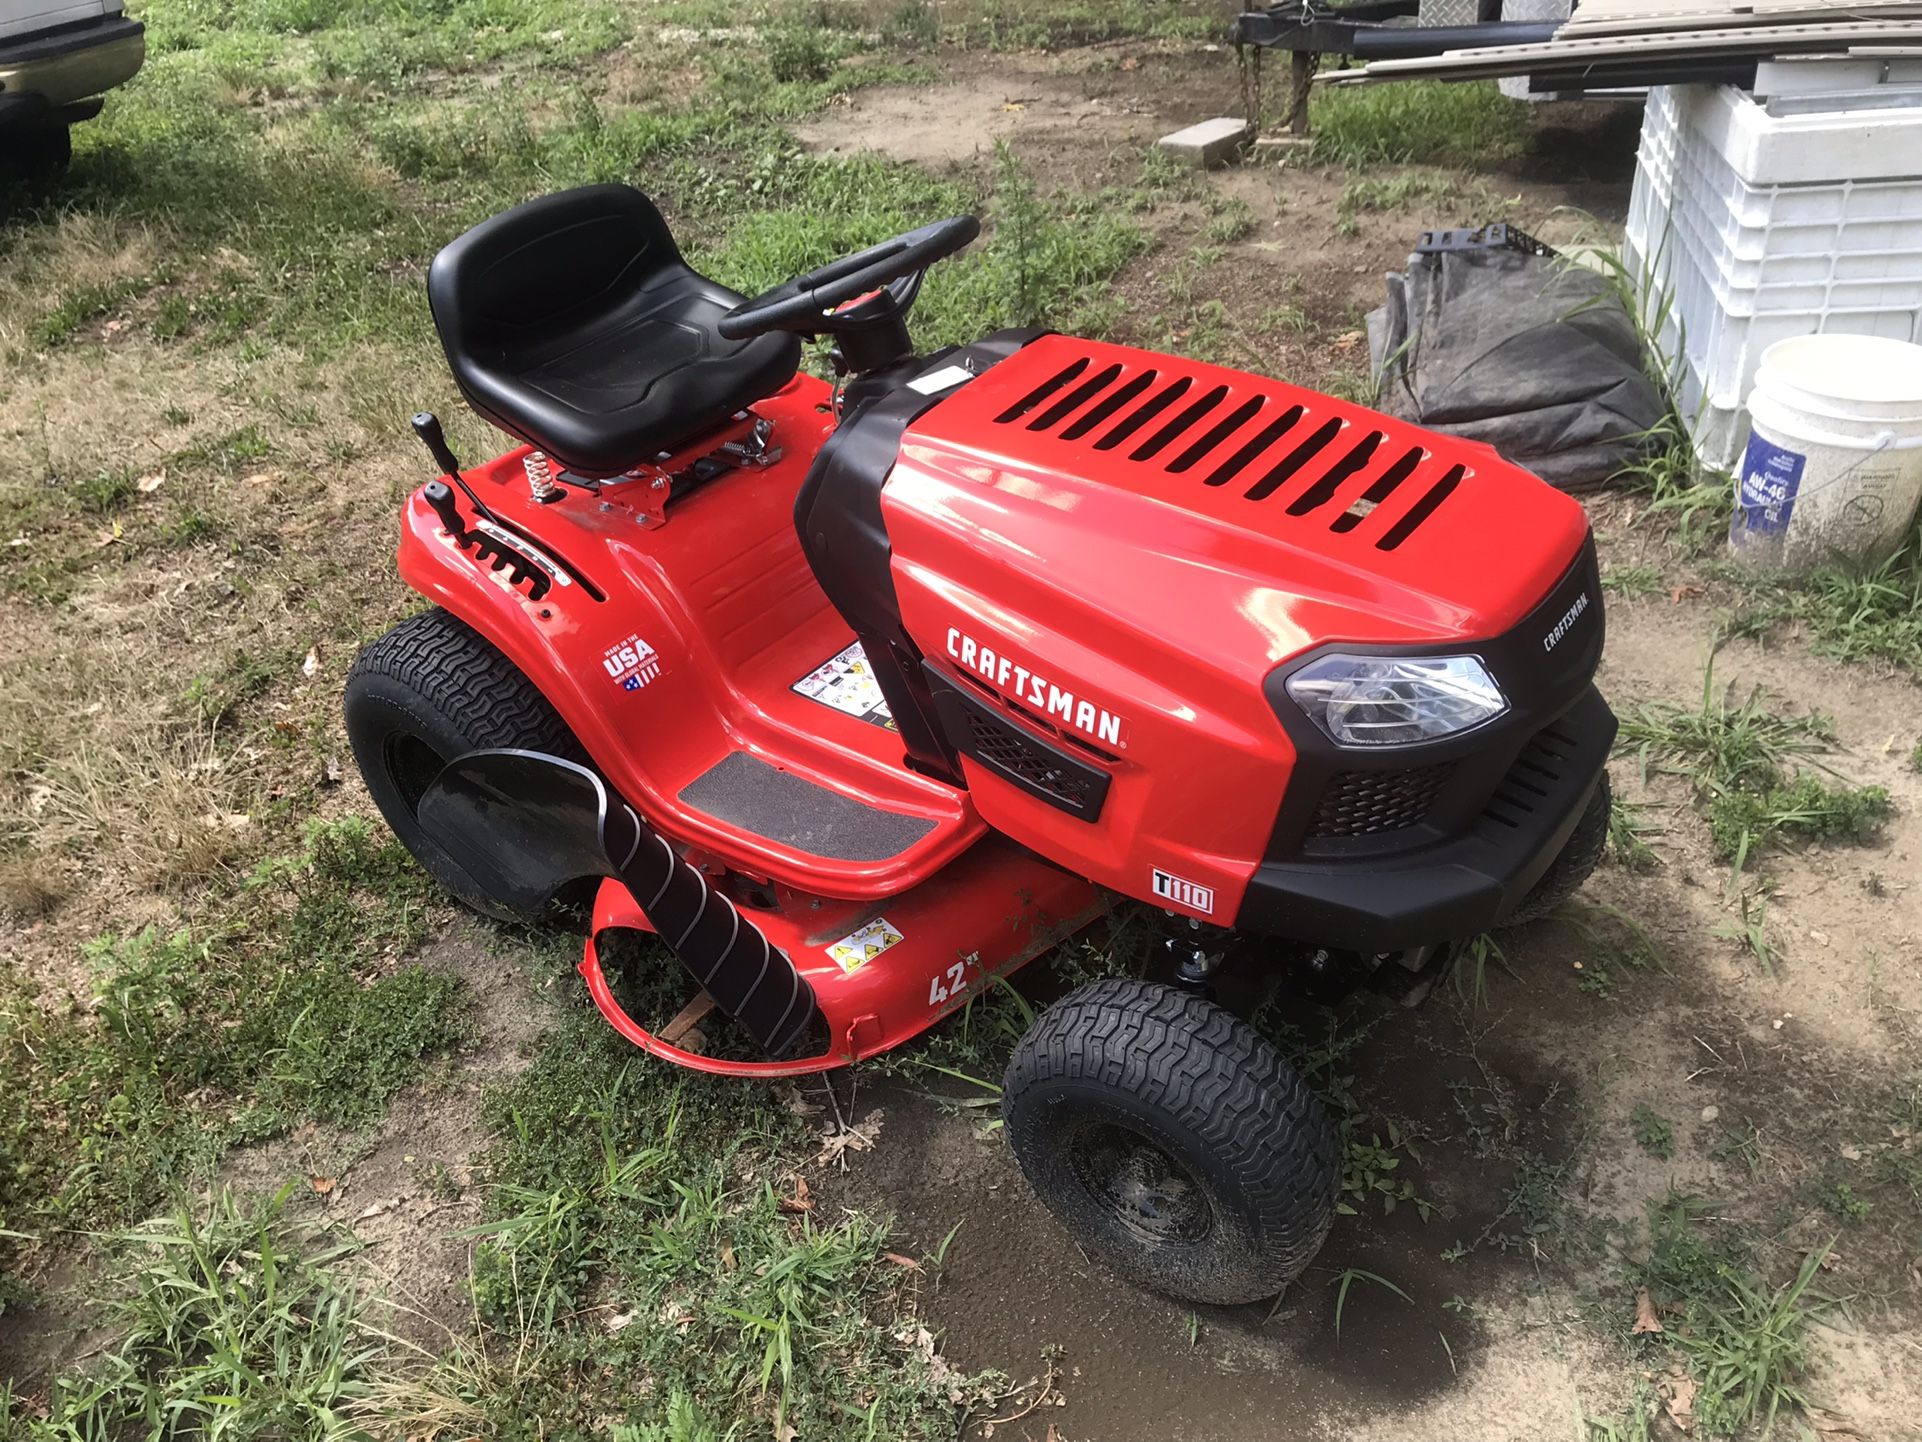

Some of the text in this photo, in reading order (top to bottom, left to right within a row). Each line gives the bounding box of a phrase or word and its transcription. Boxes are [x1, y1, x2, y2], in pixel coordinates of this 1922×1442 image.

[1748, 471, 1786, 501] AW-46
[1764, 509, 1779, 523] OIL
[1544, 592, 1588, 652] CRAFTSMAN
[603, 639, 655, 677] USA
[604, 644, 621, 657] MADE
[627, 633, 639, 643] THE
[947, 627, 1121, 745] CRAFTSMAN
[1155, 871, 1208, 909] T110
